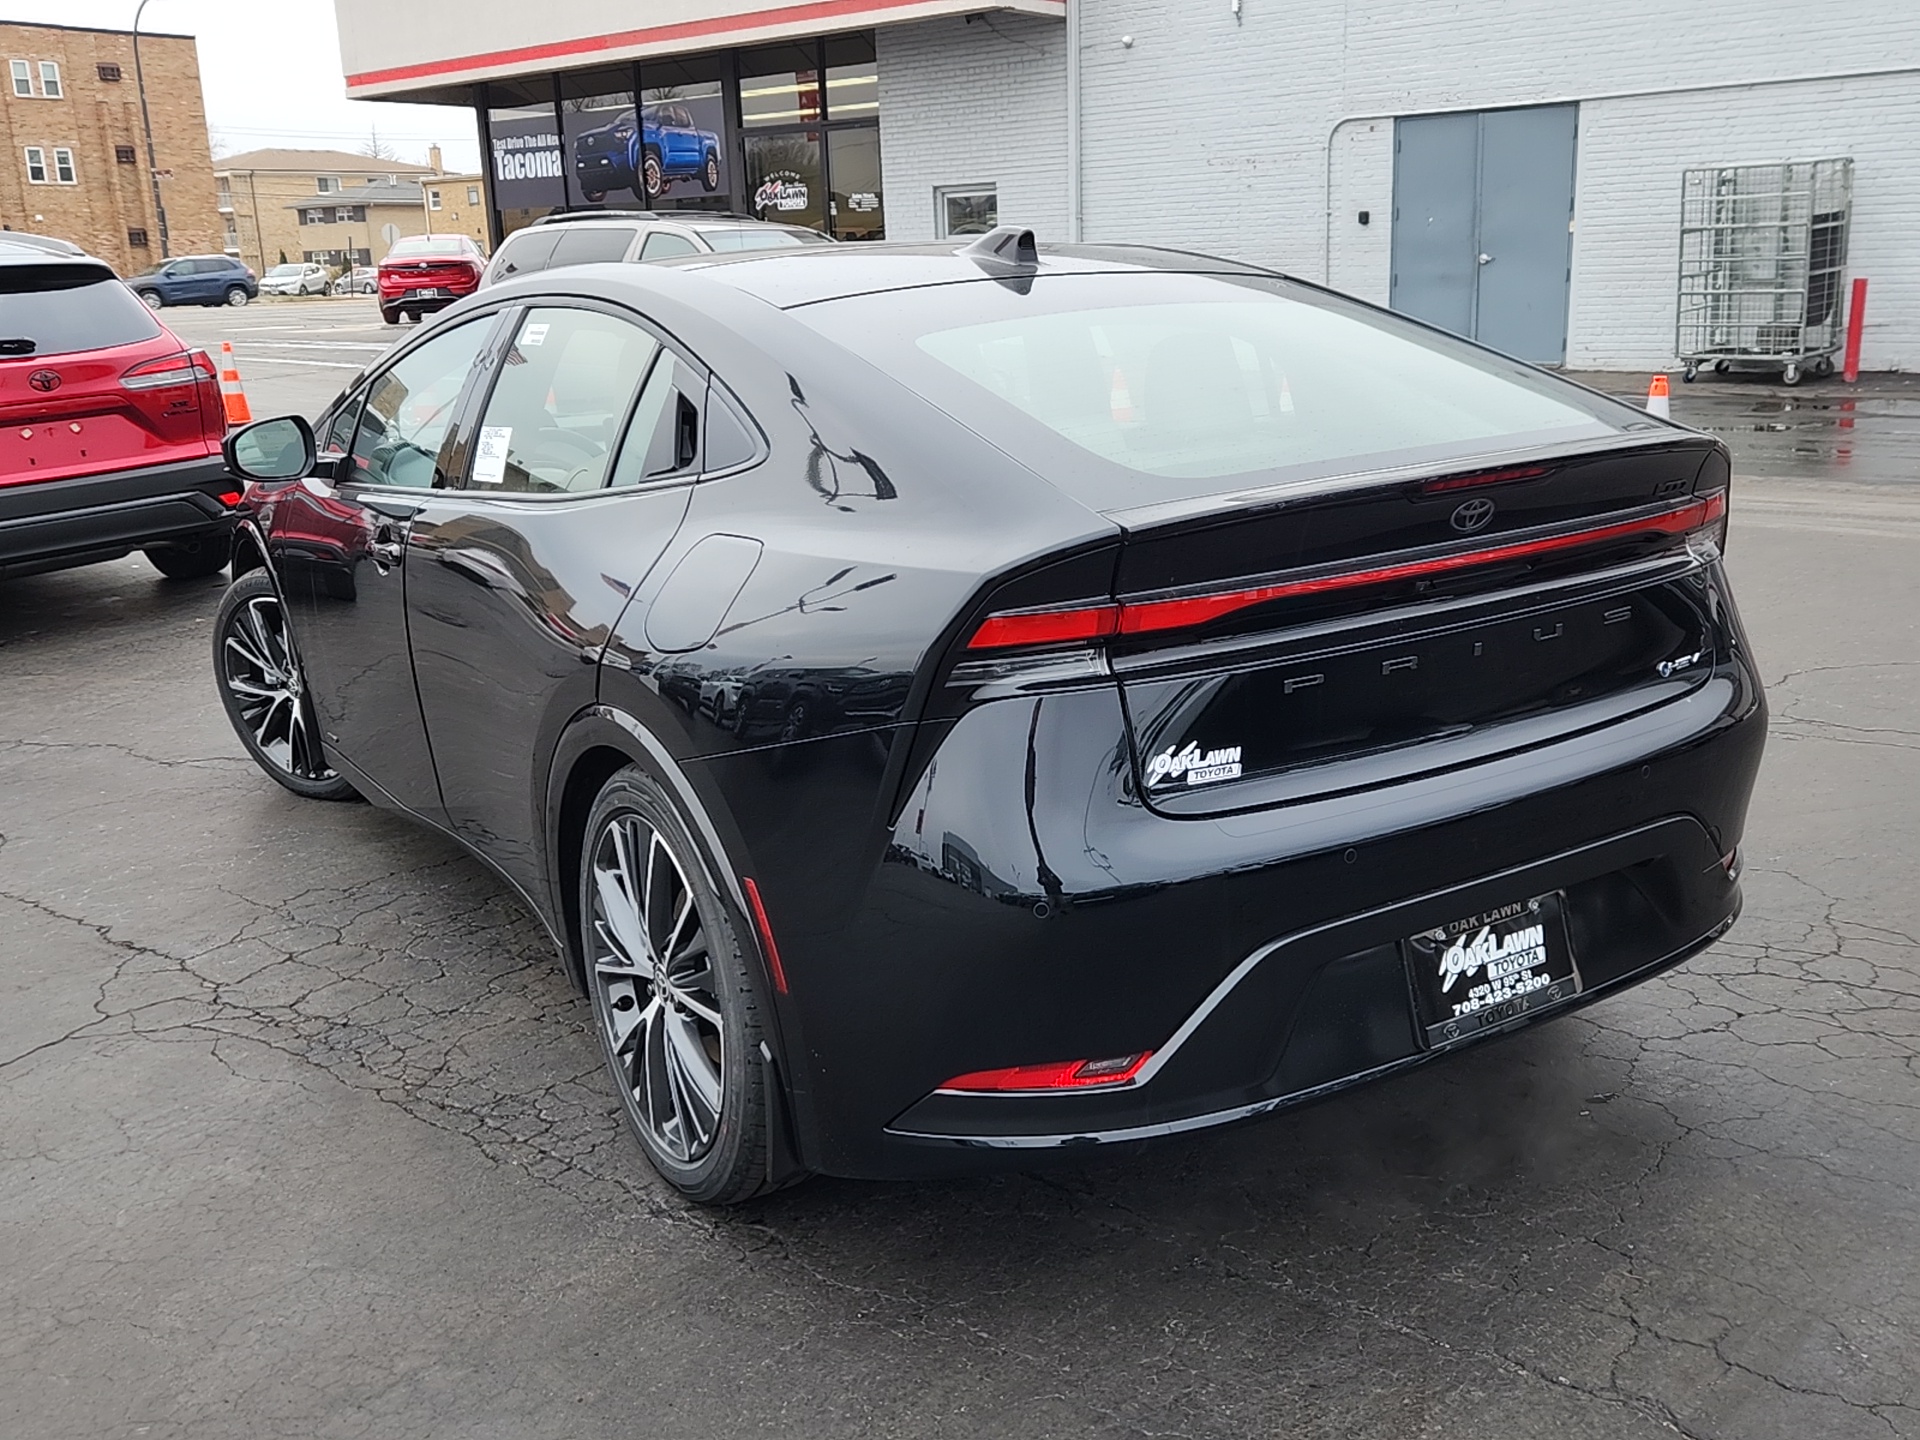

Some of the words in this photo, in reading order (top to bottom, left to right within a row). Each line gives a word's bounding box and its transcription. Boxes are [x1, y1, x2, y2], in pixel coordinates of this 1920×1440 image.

[523, 135, 537, 148] The
[494, 149, 562, 180] Tacoma
[763, 170, 801, 182] WELCOME
[1284, 605, 1633, 694] PRIUS
[1194, 765, 1234, 780] TOYOTA
[1449, 915, 1480, 933] OAK
[1483, 902, 1522, 924] LAWN
[1494, 950, 1540, 976] TOYOTA
[1451, 972, 1551, 1017] 708-423-5200
[1468, 983, 1491, 999] 4320
[1491, 979, 1502, 991] W
[1521, 969, 1533, 981] St
[1475, 996, 1534, 1027] TOYOTA
